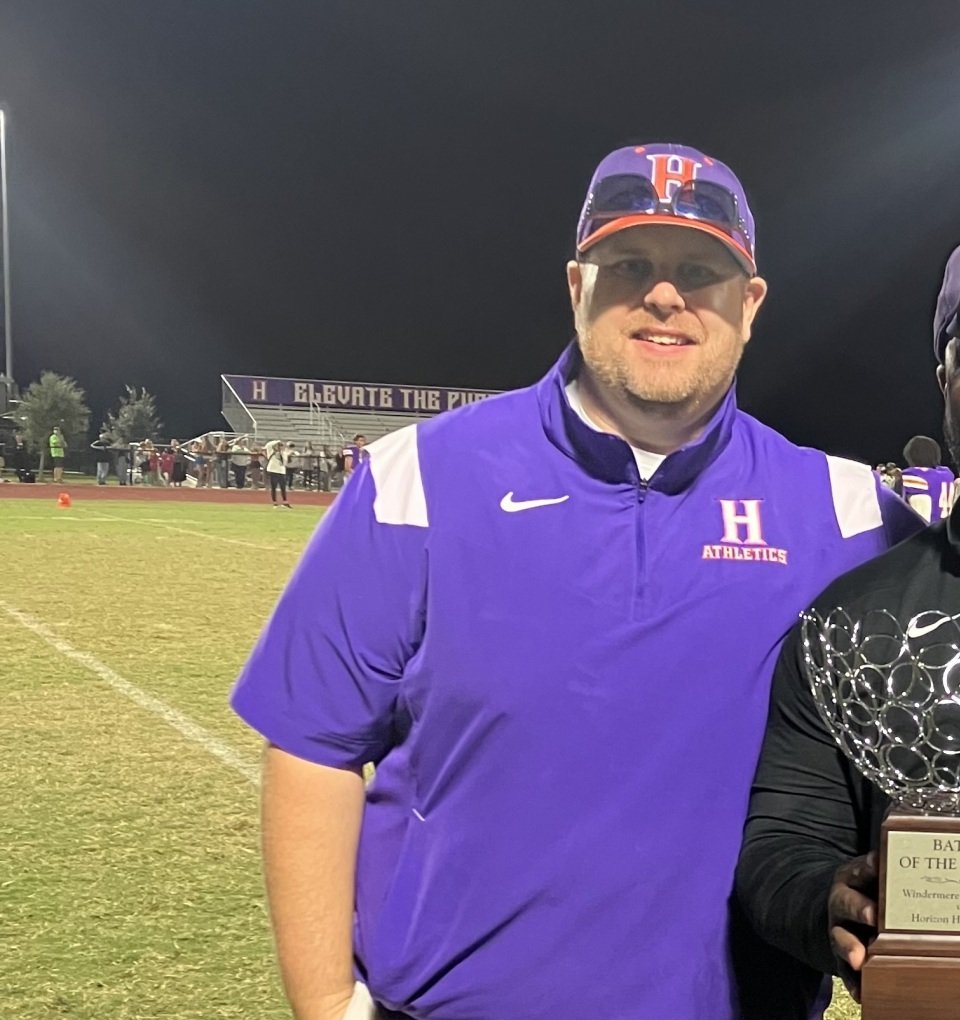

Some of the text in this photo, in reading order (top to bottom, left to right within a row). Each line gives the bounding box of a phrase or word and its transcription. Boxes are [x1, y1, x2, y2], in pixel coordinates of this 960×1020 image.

[646, 154, 702, 203] H
[253, 381, 267, 400] H
[294, 383, 393, 408] ELEVATE
[400, 388, 440, 411] THE
[719, 499, 768, 546] H
[702, 545, 788, 565] ATHLETICS
[899, 856, 921, 870] OF
[924, 857, 957, 870] THE
[902, 888, 960, 900] Windermere
[911, 913, 949, 925] Horizon
